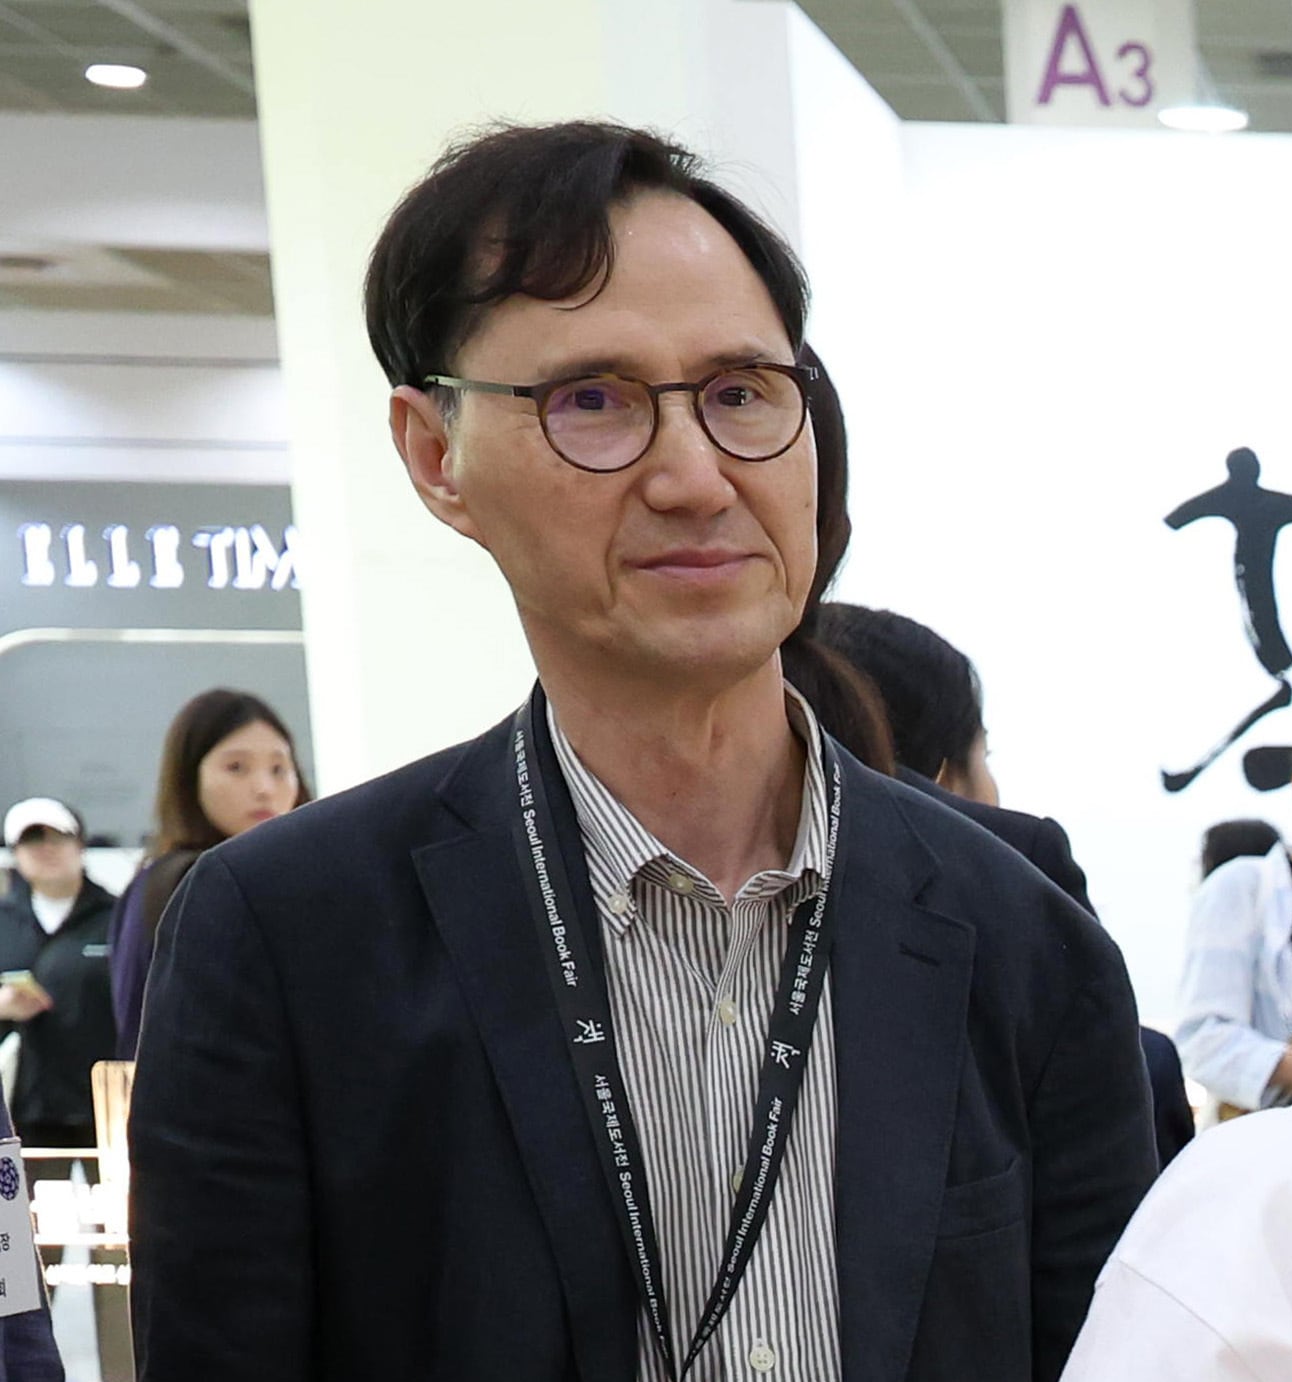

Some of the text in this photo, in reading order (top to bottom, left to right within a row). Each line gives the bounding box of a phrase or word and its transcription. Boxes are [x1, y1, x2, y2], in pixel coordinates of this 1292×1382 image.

[1037, 3, 1154, 109] A3
[523, 808, 544, 846] Seoul
[810, 890, 827, 928] Seoul
[831, 786, 843, 821] Book
[531, 845, 561, 928] International
[552, 927, 571, 959] Book
[561, 959, 578, 988] Fair
[769, 1097, 783, 1122] Fair
[762, 1120, 779, 1157] Book
[595, 1074, 629, 1167] 서울국제도서전
[619, 1171, 638, 1213] Seoul
[629, 1211, 655, 1298] International
[740, 1155, 770, 1237] International
[727, 1236, 744, 1273] Seoul
